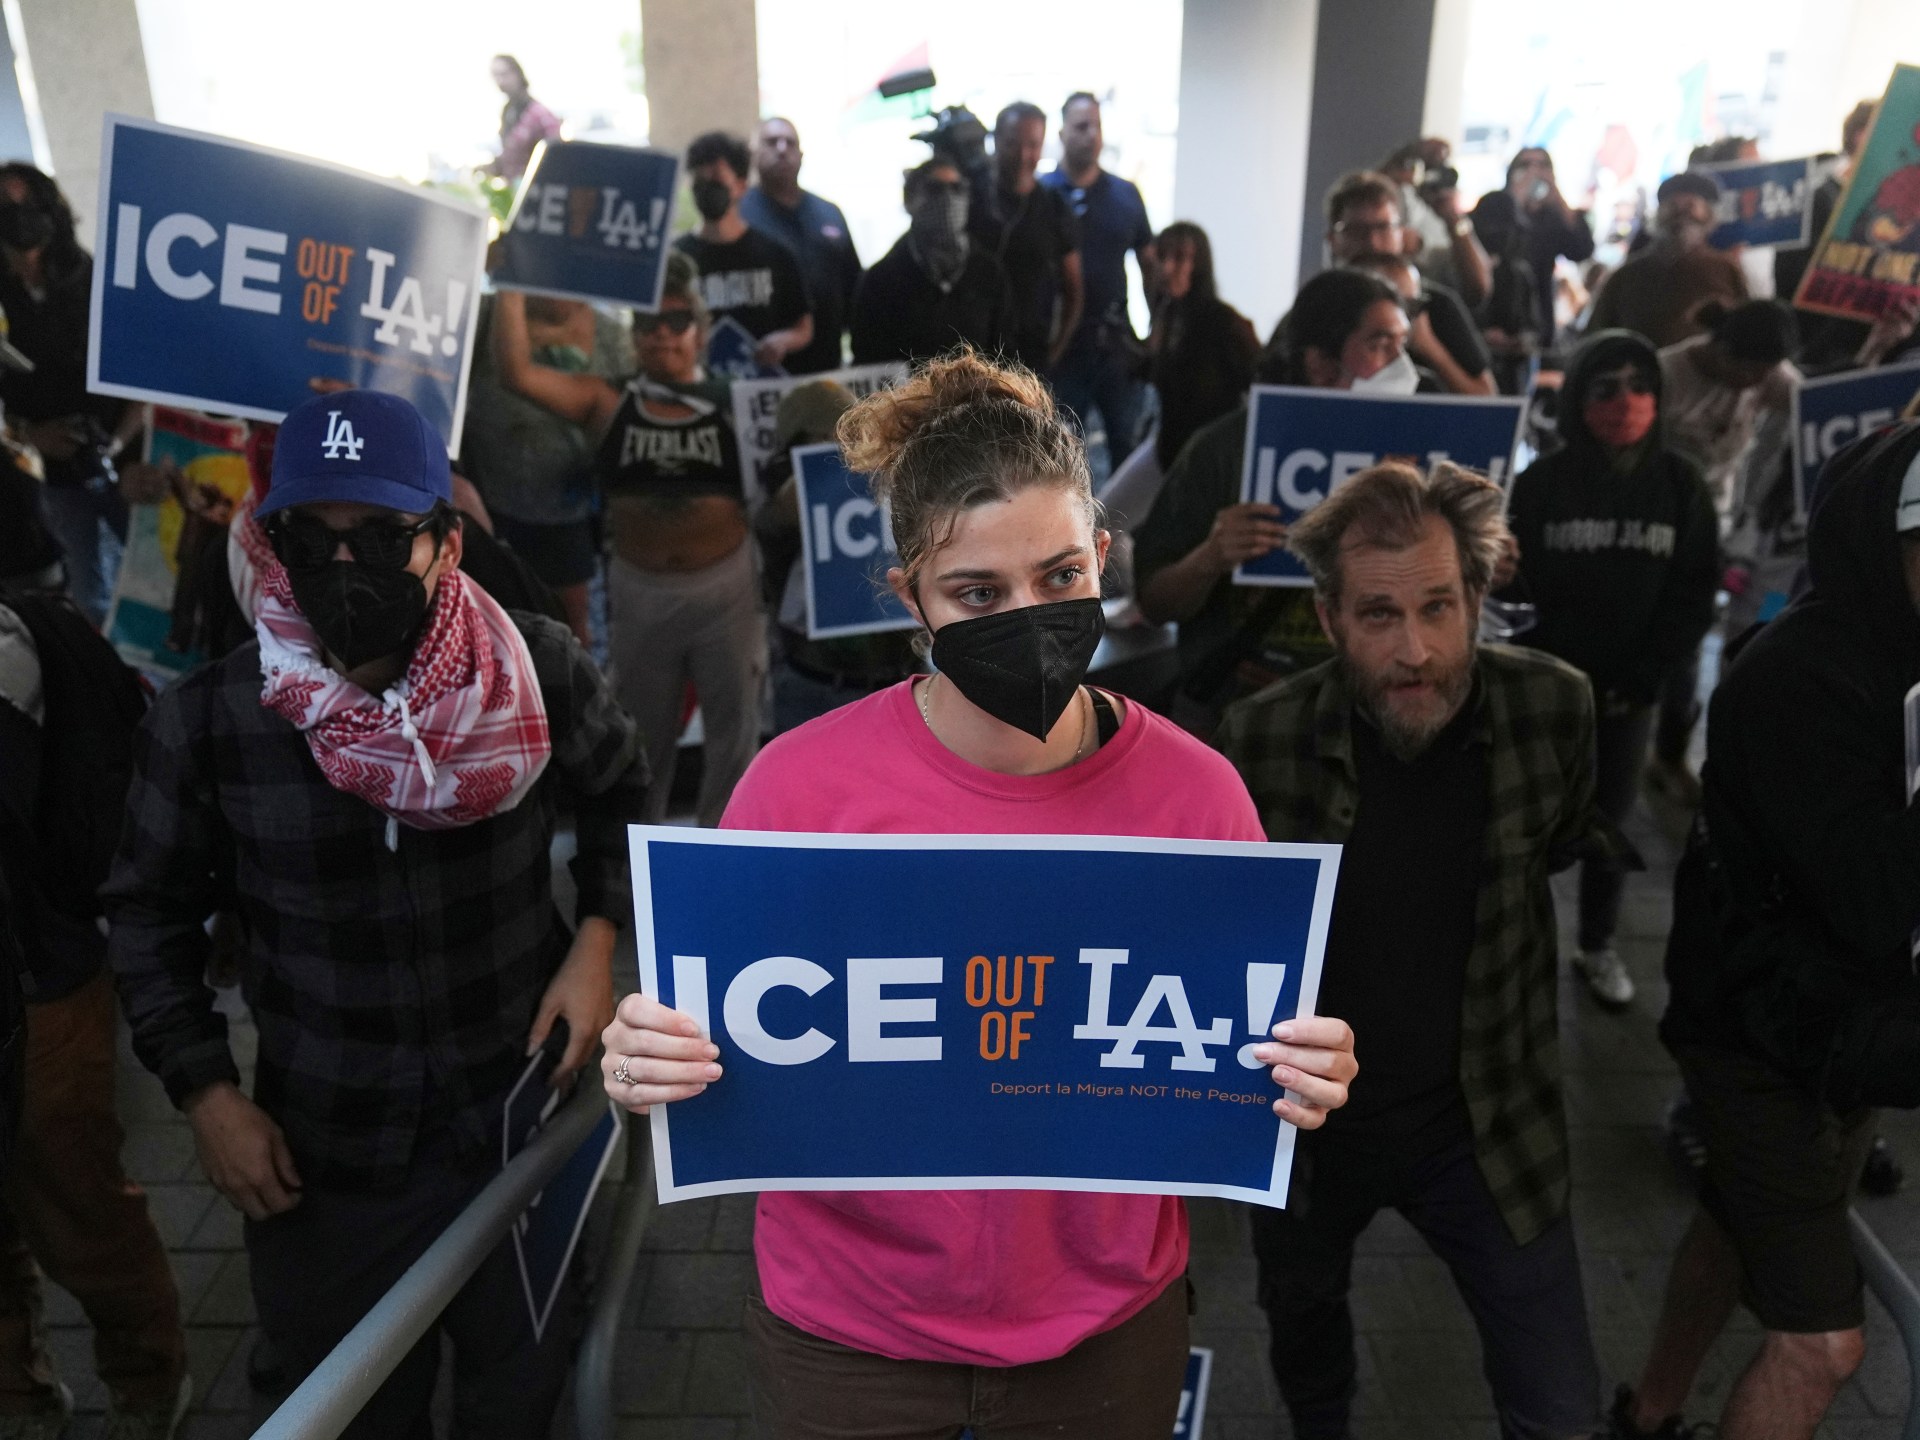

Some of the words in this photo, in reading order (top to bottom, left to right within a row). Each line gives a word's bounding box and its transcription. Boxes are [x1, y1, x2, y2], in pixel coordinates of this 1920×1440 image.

[598, 187, 666, 250] LA!
[113, 202, 289, 317] ICE
[297, 238, 353, 285] OUT
[303, 281, 342, 325] OF
[360, 247, 467, 357] LA!
[321, 411, 365, 460] LA
[965, 955, 1055, 1008] OUT
[672, 954, 944, 1066] ICE
[979, 1011, 1035, 1061] OF
[1073, 947, 1286, 1073] LA!
[991, 1082, 1051, 1096] Deport
[1056, 1083, 1071, 1095] la
[1077, 1083, 1124, 1097] Migra
[1130, 1085, 1168, 1097] NOT
[1175, 1086, 1202, 1100] the
[1208, 1089, 1267, 1106] People
